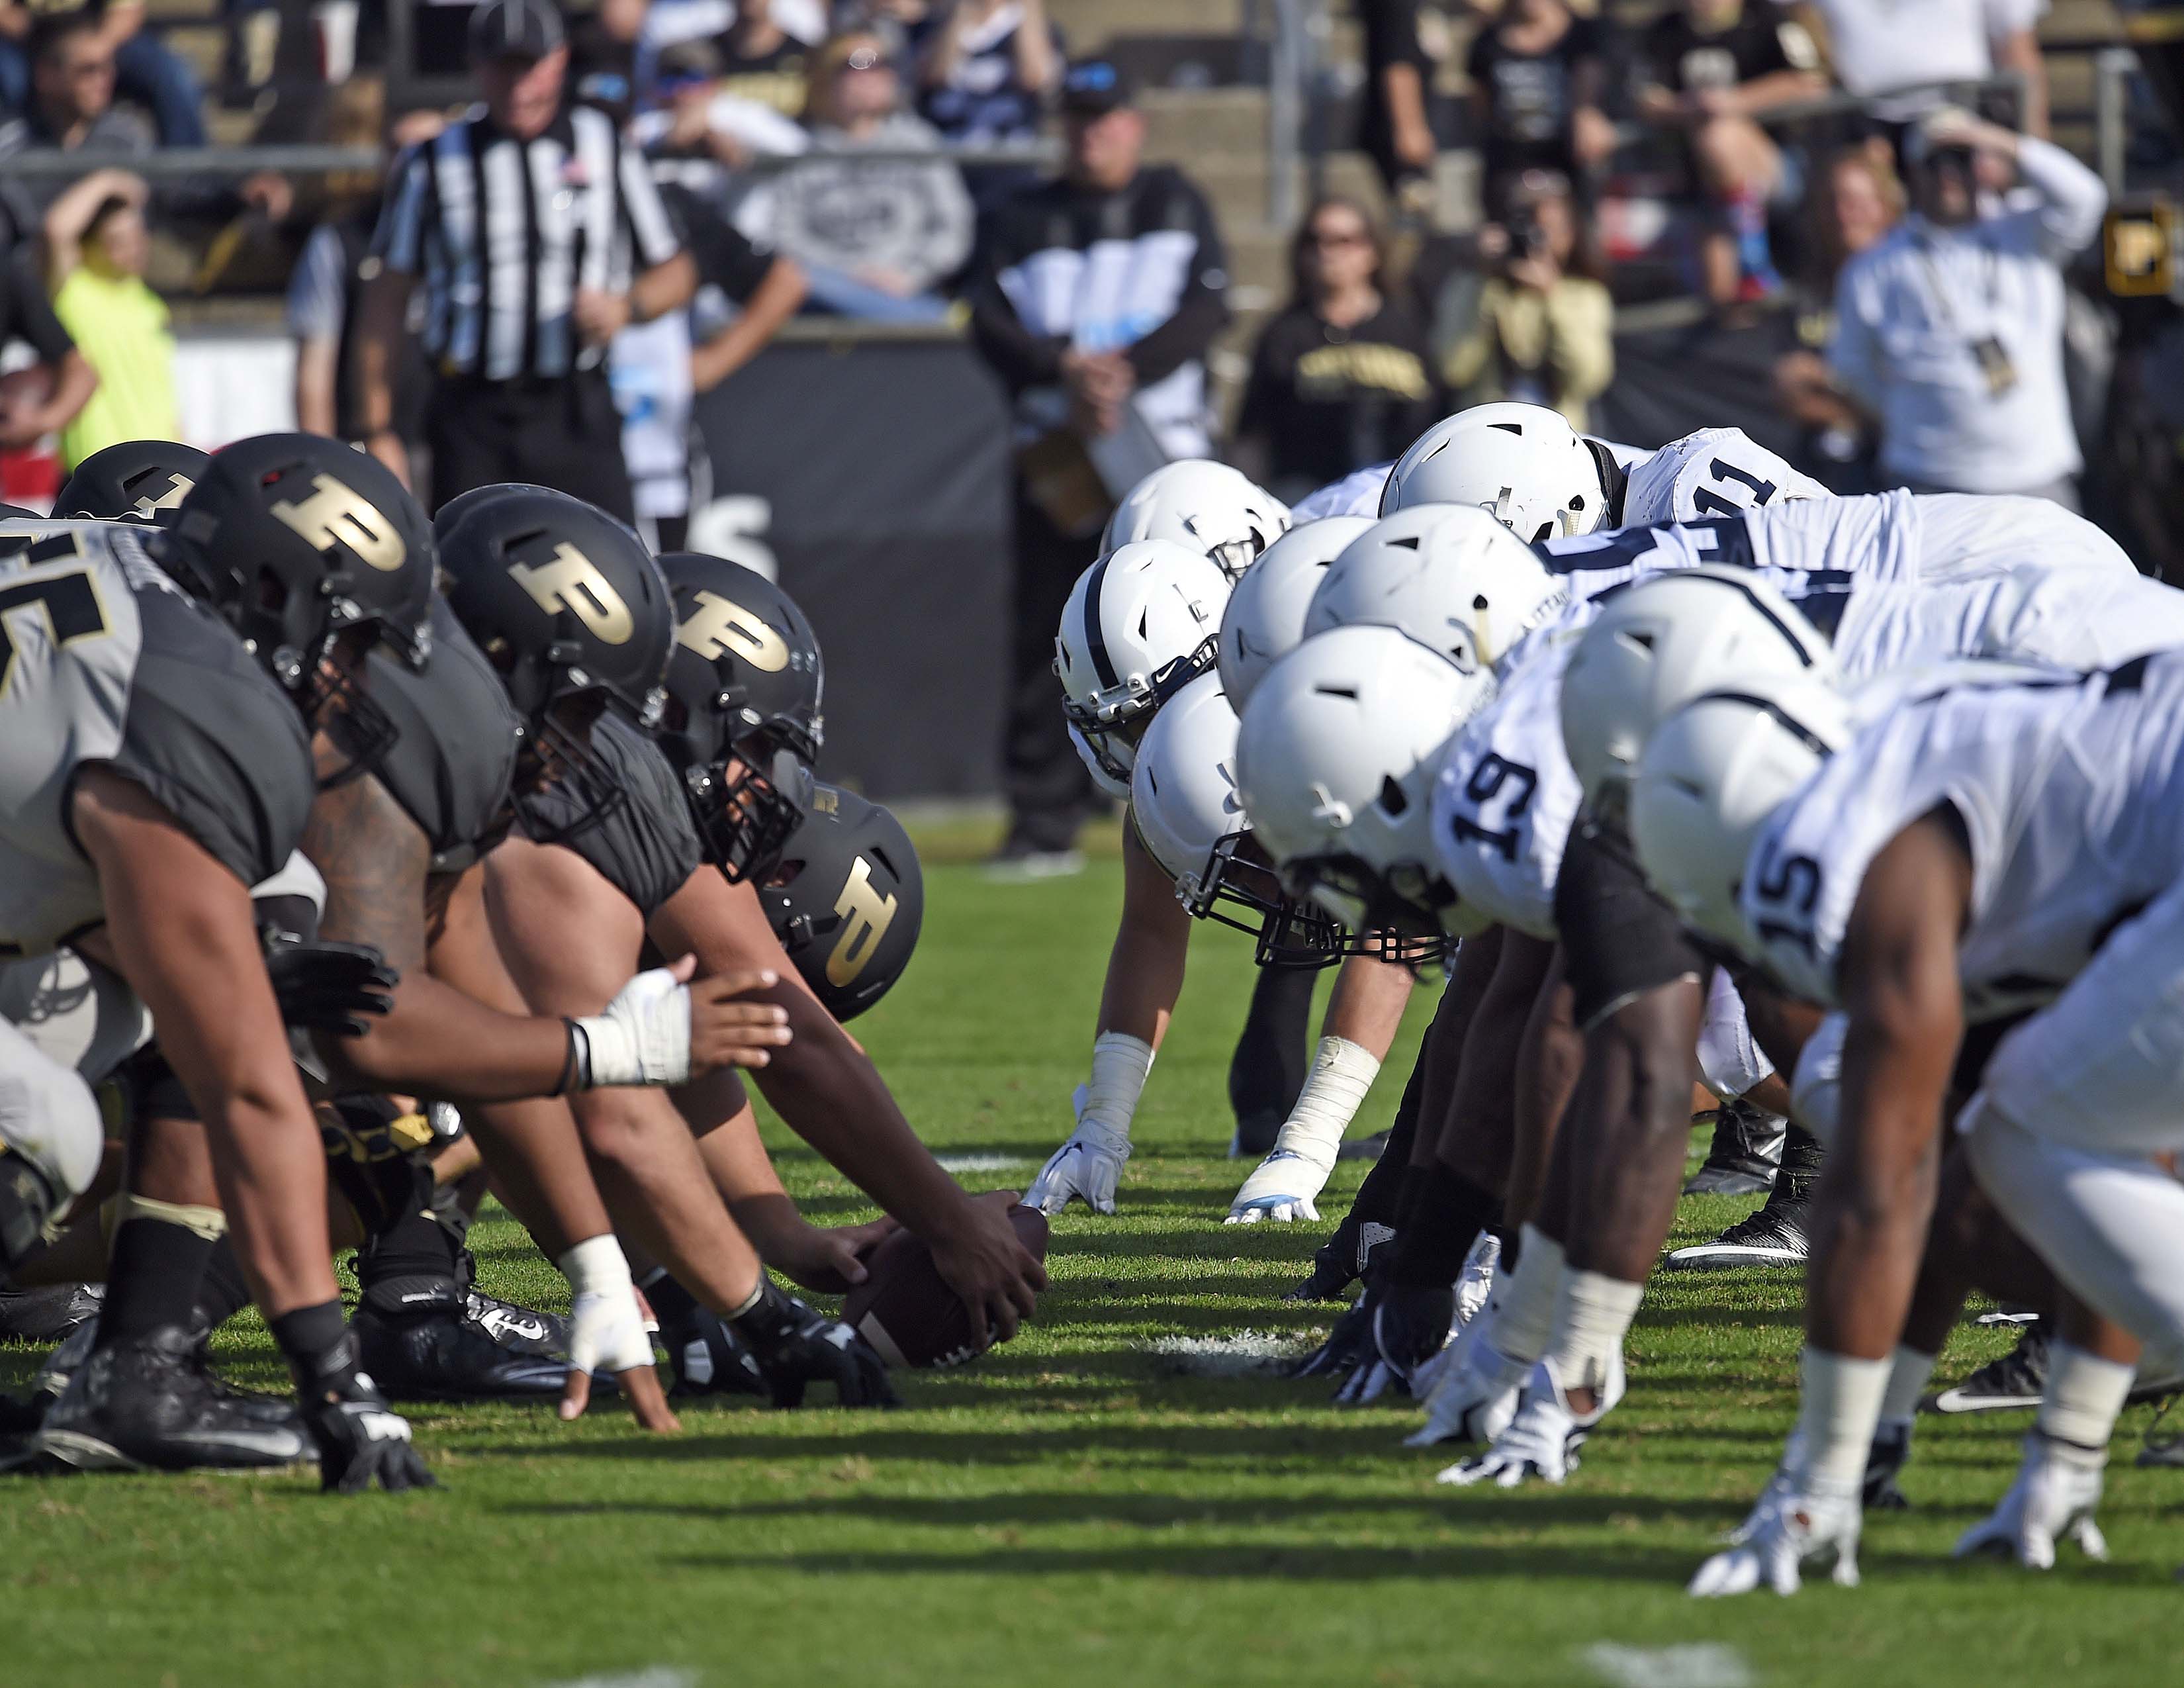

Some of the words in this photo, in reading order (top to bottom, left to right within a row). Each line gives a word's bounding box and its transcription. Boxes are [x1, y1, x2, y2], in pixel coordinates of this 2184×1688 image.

[269, 473, 408, 572] P
[1692, 457, 1777, 519] 11
[507, 541, 635, 645] P
[676, 589, 790, 673] P
[1453, 752, 1537, 862] 19
[826, 855, 897, 988] P
[1758, 839, 1822, 964] 15
